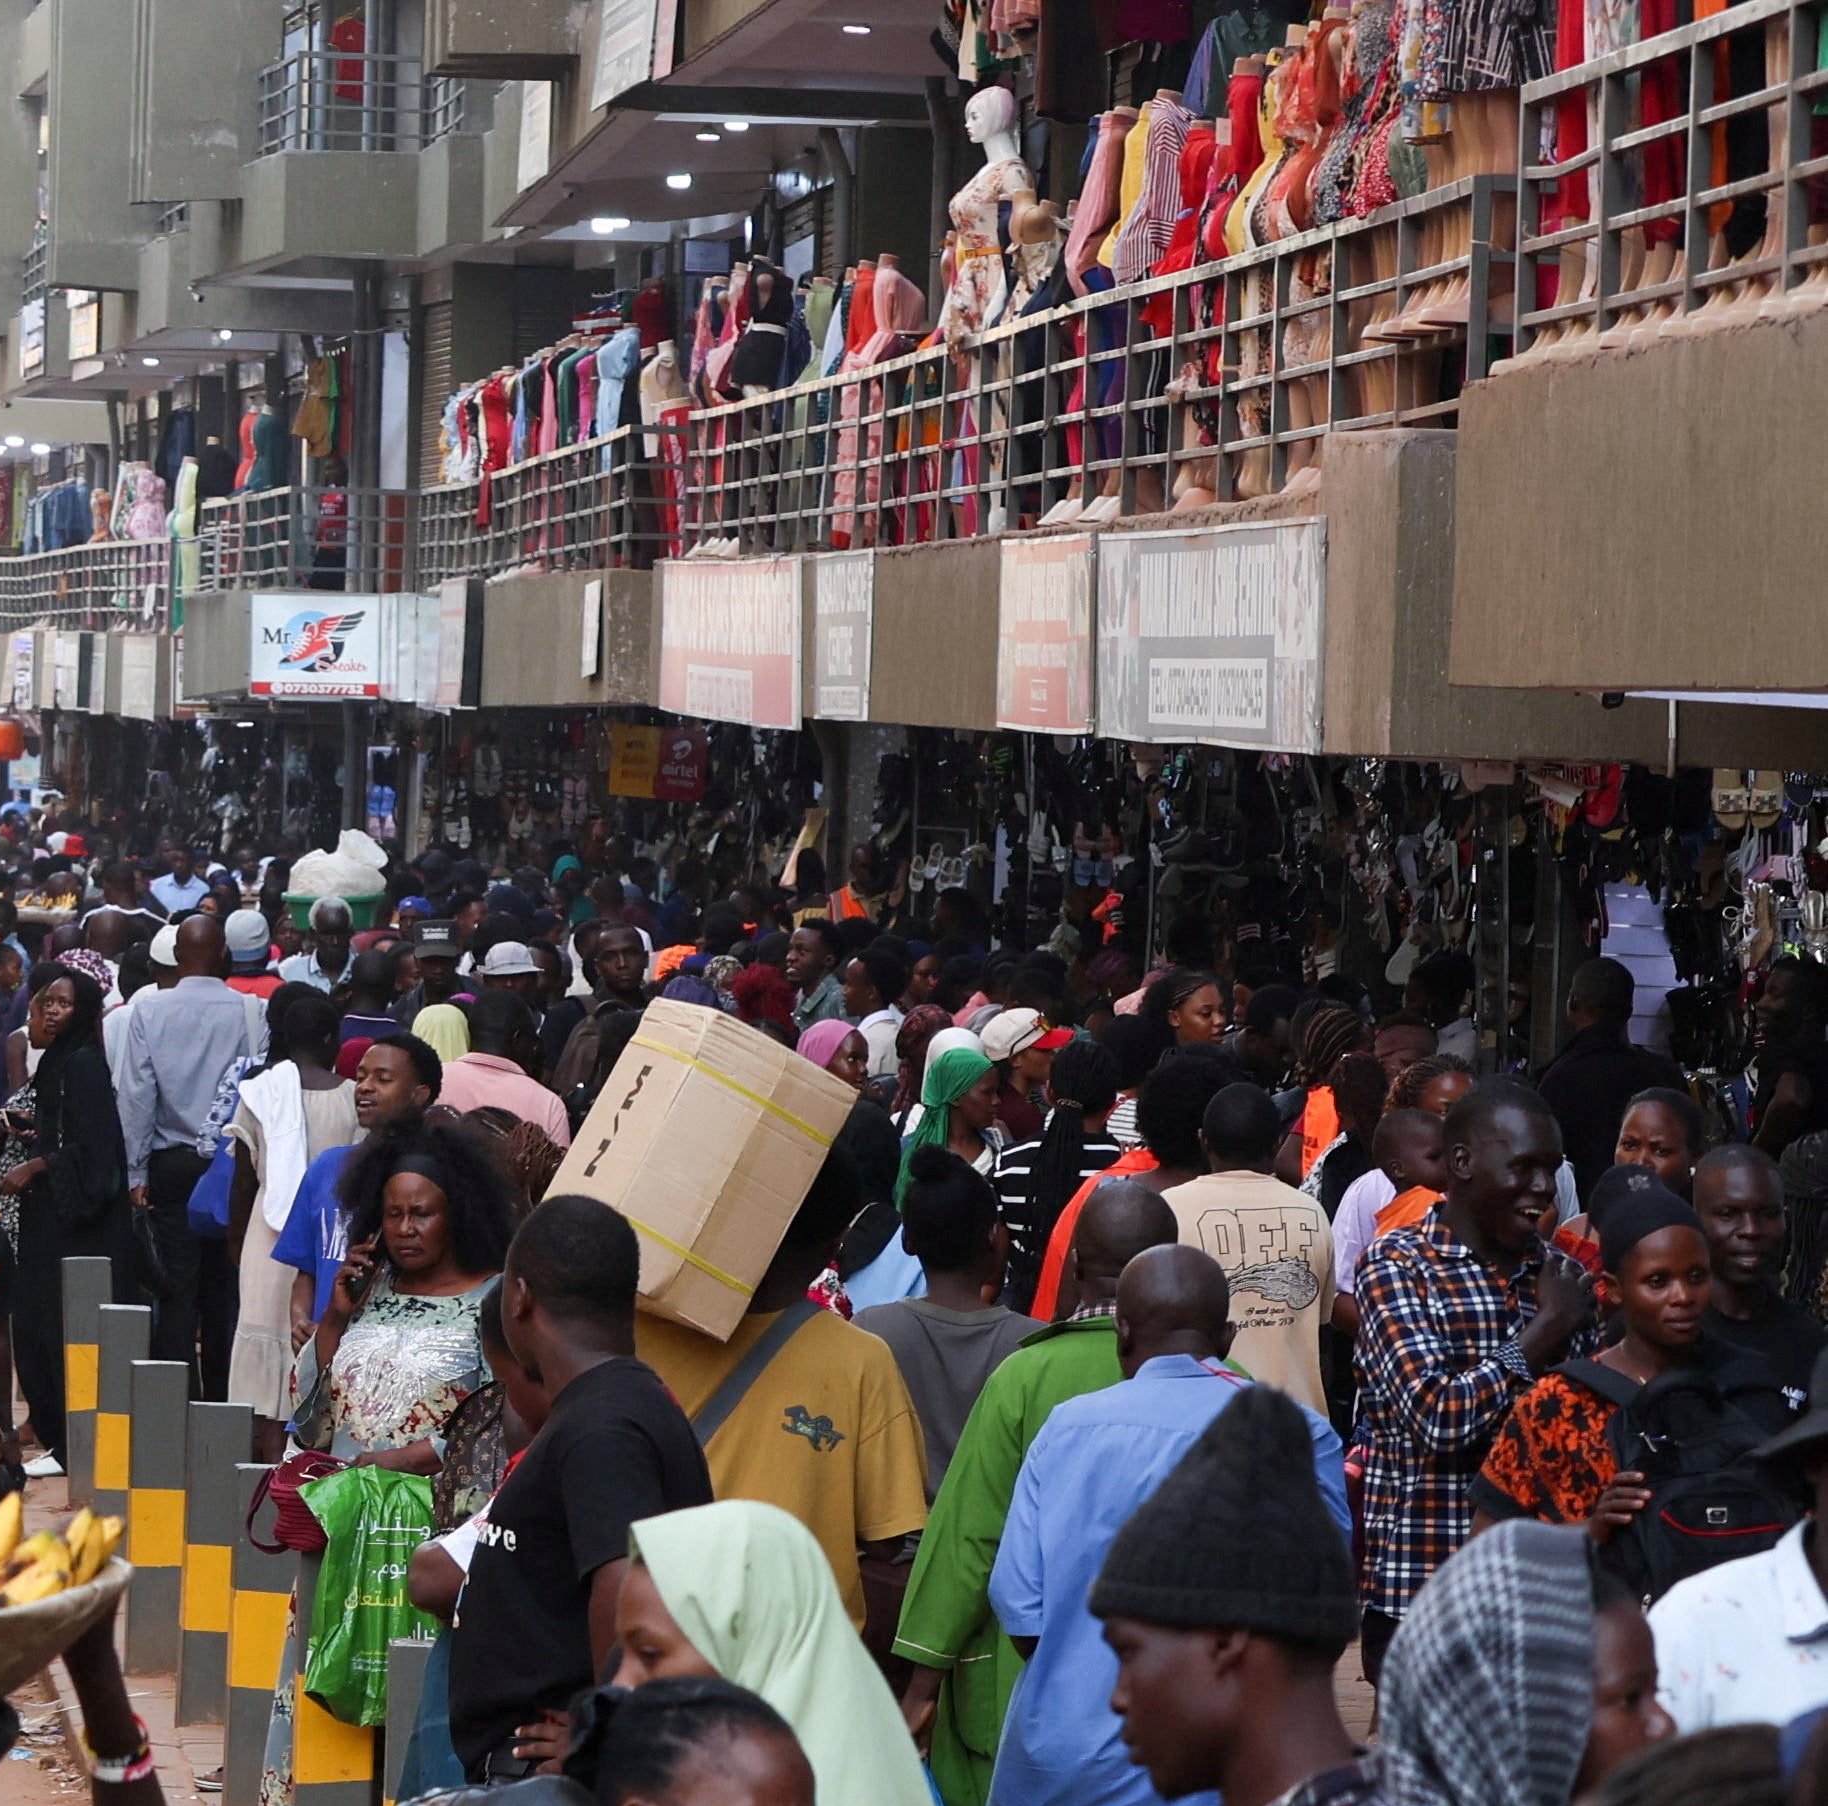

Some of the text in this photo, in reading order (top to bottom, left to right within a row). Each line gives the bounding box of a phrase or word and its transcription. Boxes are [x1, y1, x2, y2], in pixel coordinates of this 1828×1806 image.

[263, 627, 295, 644] Mr.
[315, 654, 368, 672] Sneaker
[662, 762, 698, 778] airtel
[1197, 1208, 1319, 1272] OFF
